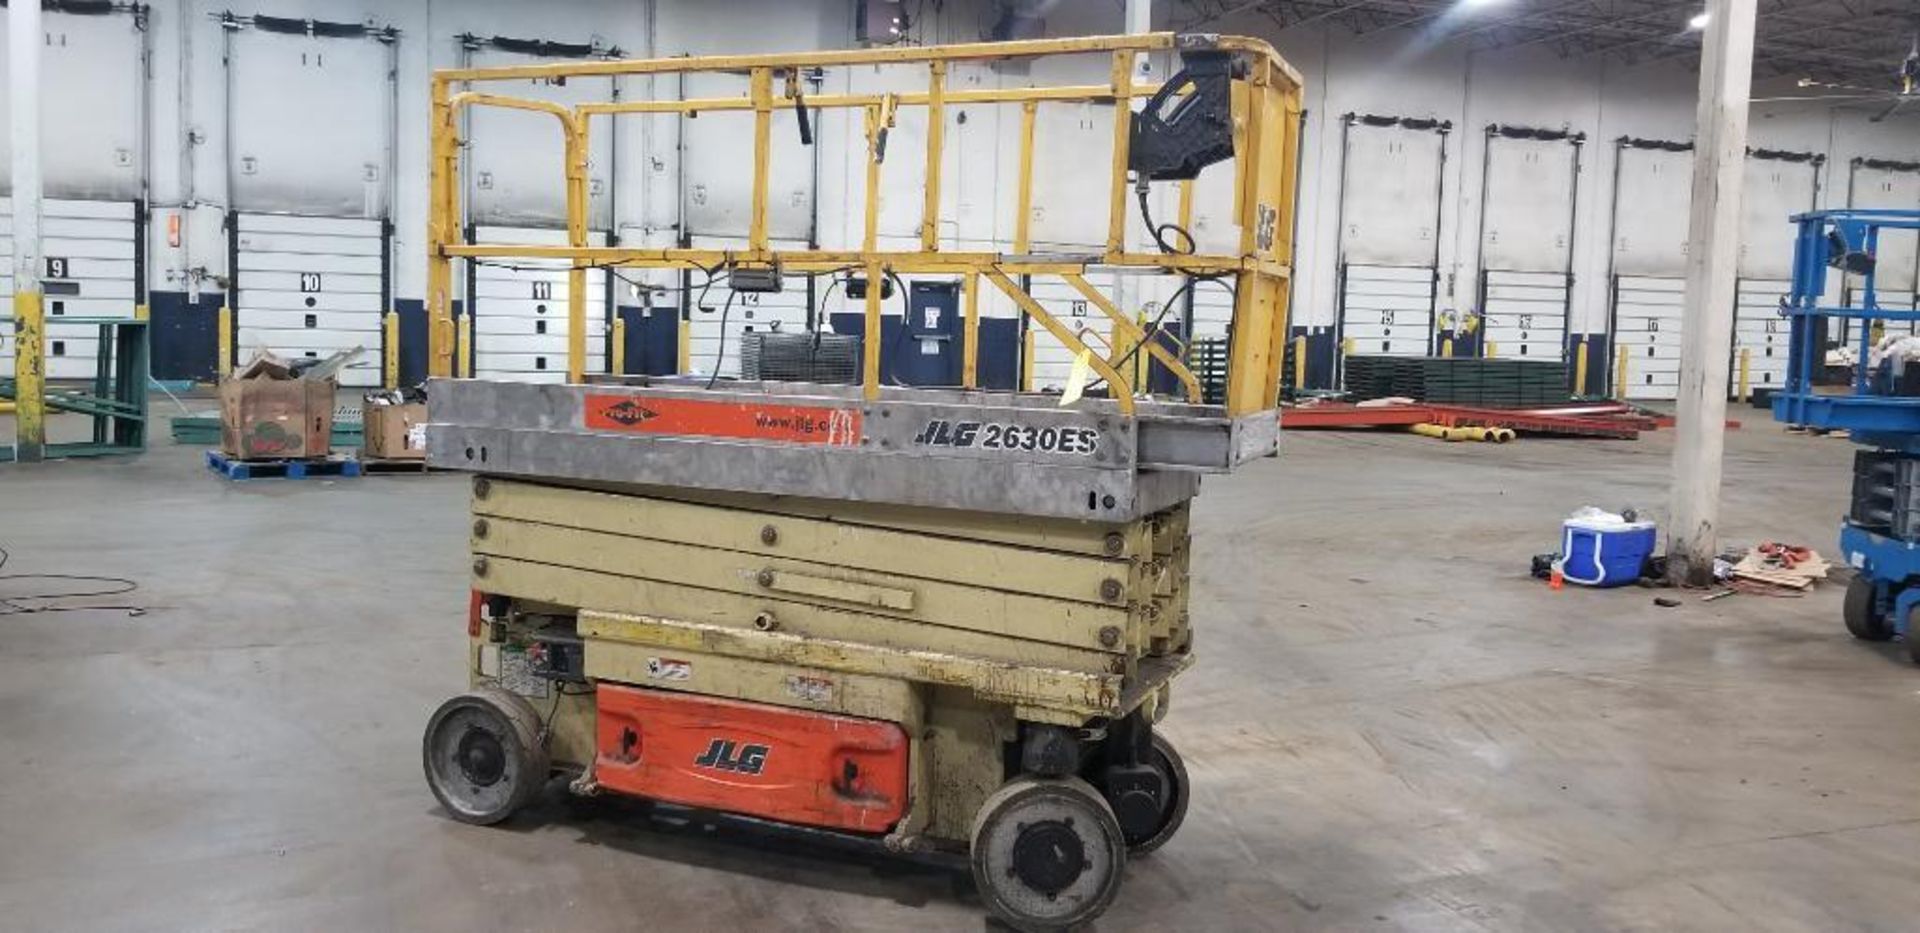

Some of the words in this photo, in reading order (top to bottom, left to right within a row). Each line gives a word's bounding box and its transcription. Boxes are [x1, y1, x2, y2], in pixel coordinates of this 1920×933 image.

[51, 259, 63, 277] 9
[303, 274, 319, 291] 10
[535, 282, 549, 299] 11
[914, 421, 981, 447] JLG
[983, 424, 1098, 453] 2630ES
[693, 738, 771, 776] JLG
